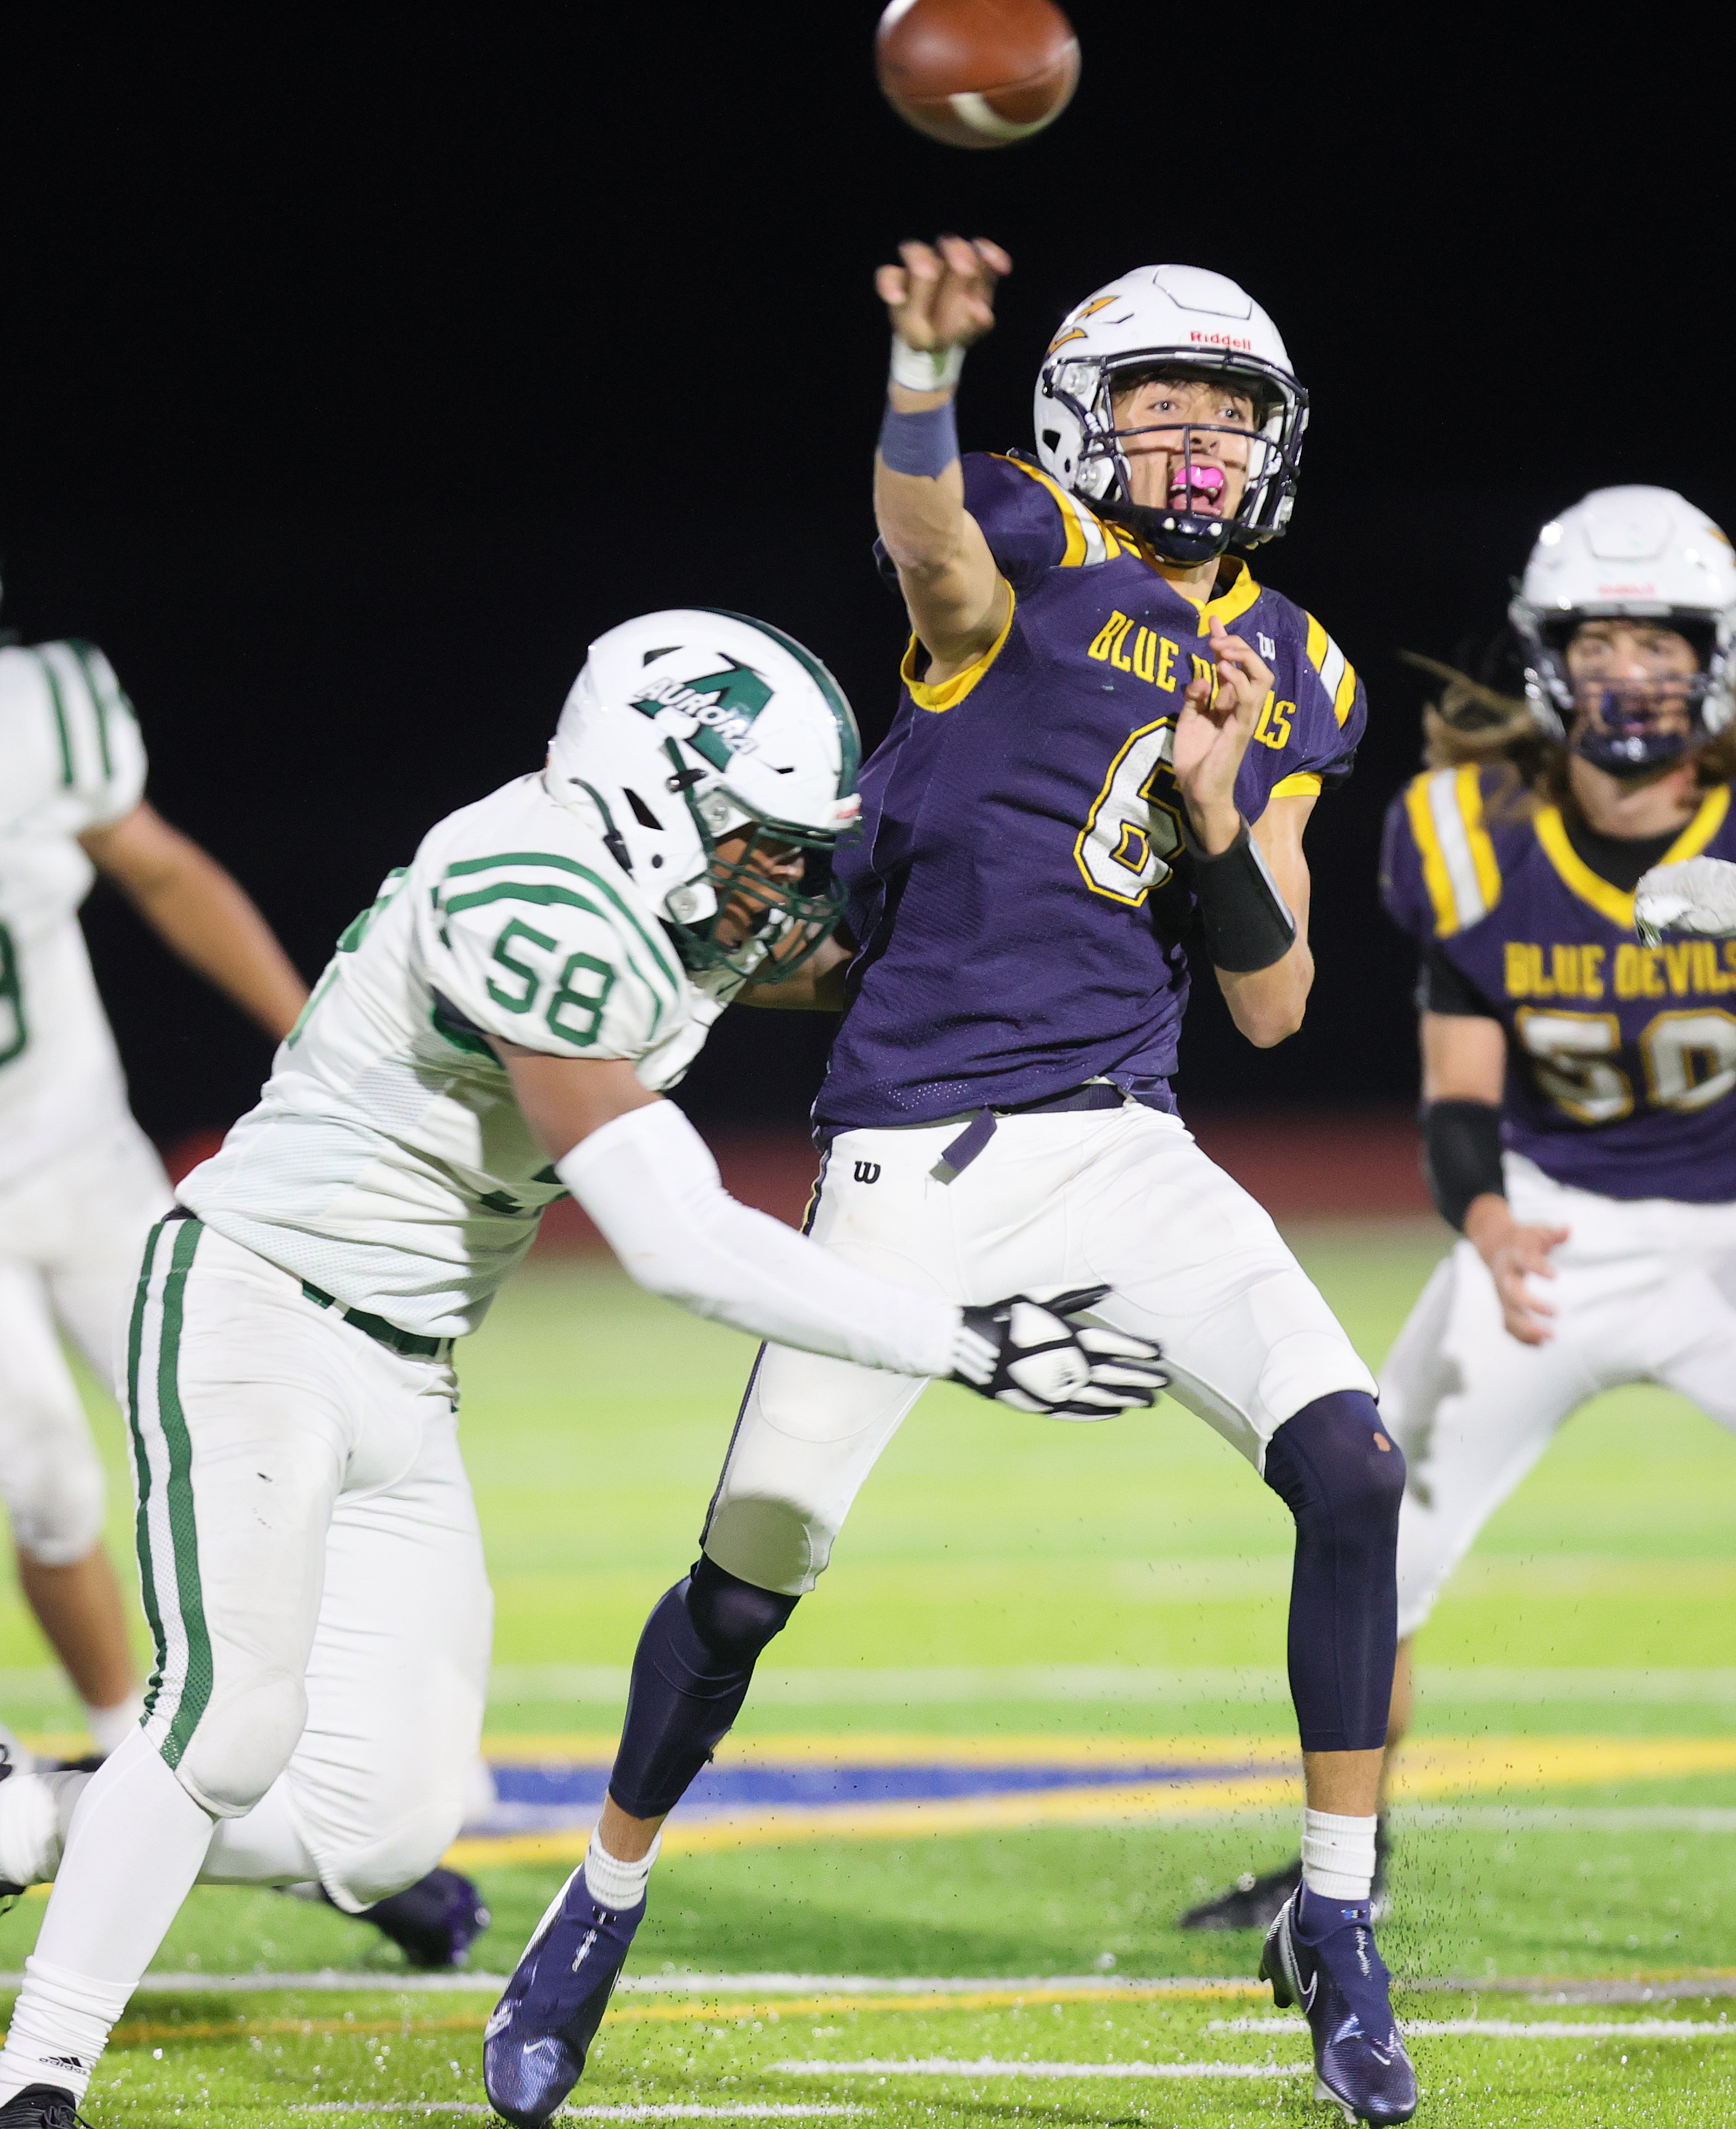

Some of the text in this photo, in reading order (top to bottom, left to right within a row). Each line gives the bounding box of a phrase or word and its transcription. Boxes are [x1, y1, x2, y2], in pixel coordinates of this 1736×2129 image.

[1190, 330, 1252, 351] Riddell
[1087, 609, 1297, 750] BLUE DLS
[1073, 716, 1186, 907] 6
[485, 917, 617, 1047] 58
[1503, 941, 1606, 999] BLUE
[1514, 1005, 1736, 1125] 50
[39, 2056, 87, 2075] adidas
